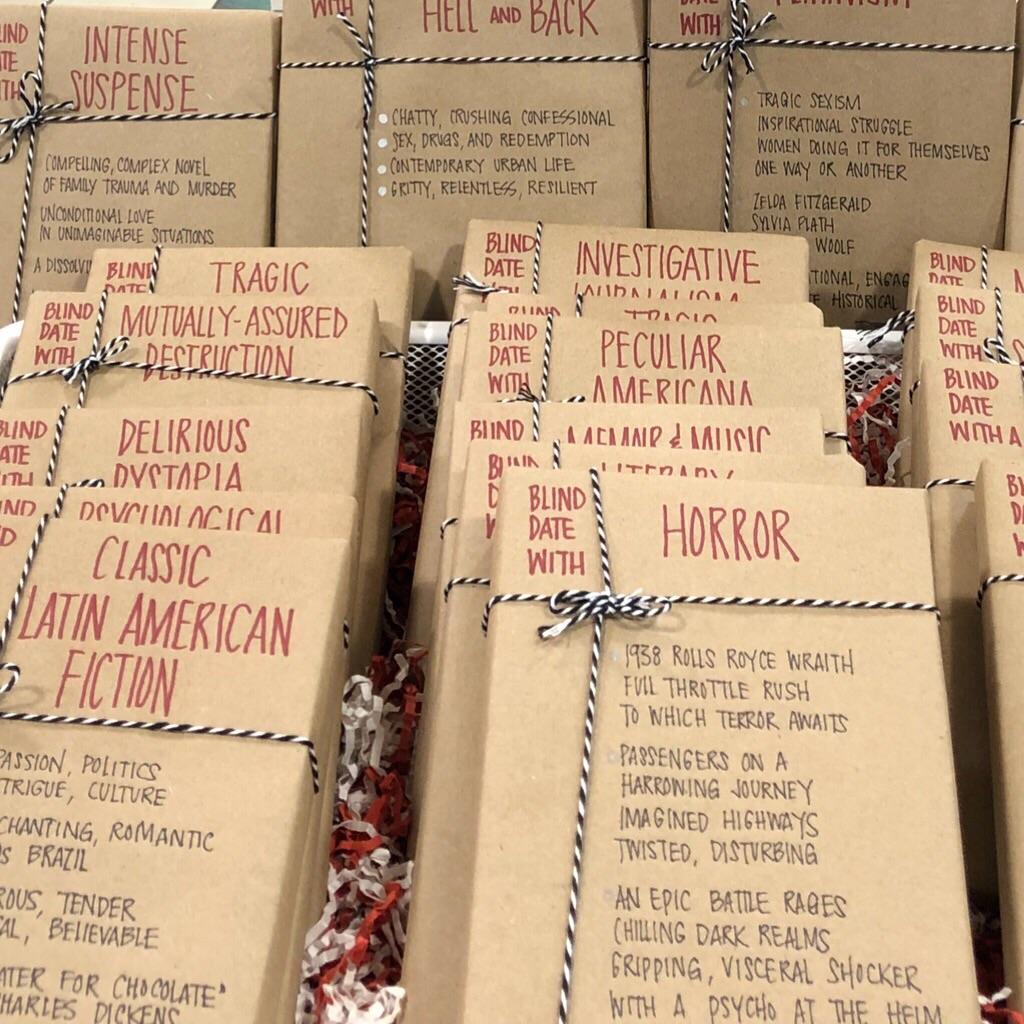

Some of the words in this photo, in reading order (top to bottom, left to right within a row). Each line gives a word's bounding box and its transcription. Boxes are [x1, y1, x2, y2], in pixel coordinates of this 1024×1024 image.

[490, 6, 521, 23] AND
[680, 12, 720, 36] WITH
[84, 26, 187, 65] INTENSE
[71, 71, 199, 113] SUSPENSE
[758, 91, 801, 108] TRAGIC
[810, 92, 860, 110] SEXISM
[392, 109, 441, 129] CHATTY,
[451, 108, 511, 125] CRUSHING
[522, 110, 614, 126] CONFESSIONAL
[759, 116, 843, 133] INSPIRATIONAL
[851, 117, 912, 136] STRUGGLE
[393, 132, 416, 152] SEX,
[422, 132, 463, 150] DRUGS,
[500, 132, 589, 147] REDEMPTION
[758, 138, 800, 153] WOMEN
[810, 140, 848, 156] DOING
[909, 142, 990, 161] THEMSELVES
[117, 157, 169, 174] COMPLEX
[175, 157, 210, 176] NOVEL
[390, 157, 484, 175] CONTEMPORARY
[494, 157, 537, 172] URBAN
[545, 157, 575, 172] LIFE
[846, 161, 907, 181] ANOTHER
[60, 177, 97, 195] FAMILY
[103, 178, 149, 195] TRAUMA
[188, 180, 236, 198] MURDER
[528, 180, 597, 195] RESILIENT
[41, 204, 122, 224] UNCONDITIONAL
[754, 192, 786, 210] ZELDA
[795, 194, 871, 212] FITZGERALD
[58, 226, 143, 243] UNIMAGINABLE
[152, 228, 214, 244] SITUATIONS
[752, 213, 791, 231] SYLVIA
[798, 216, 834, 233] PLATH
[577, 240, 760, 284] INVESTIGATIVE
[210, 262, 309, 295] TRAGIC
[121, 305, 347, 338] MUTUALLY-ASSURED
[144, 344, 294, 382] DESTRUCTION
[602, 330, 726, 373] PECULIAR
[944, 368, 999, 390] BLIND
[949, 393, 993, 416] DATE
[118, 418, 249, 456] DELIRIOUS
[529, 485, 586, 512] BLIND
[529, 515, 575, 540] DATE
[663, 503, 799, 562] HORROR
[93, 536, 211, 588] CLASSIC
[528, 549, 585, 575] WITH
[18, 585, 110, 641] LATIN
[118, 593, 294, 656] AMERICAN
[626, 644, 660, 669] 1938
[673, 645, 715, 668] ROLLS
[727, 649, 775, 672] ROYCE
[787, 649, 854, 675] WRAITH
[55, 650, 178, 717] FICTION
[624, 675, 656, 696] FULL
[663, 677, 748, 699] THROTTLE
[763, 680, 809, 701] RUSH
[649, 706, 706, 727] WHICH
[716, 710, 780, 730] TERROR
[789, 711, 848, 733] AWAITS
[82, 754, 161, 781] POLITICS
[620, 744, 728, 771] PASSENGERS
[88, 781, 166, 806] CULTURE
[622, 773, 719, 800] HARROWING
[731, 779, 813, 805] JOURNEY
[109, 821, 214, 851] ROMANTIC
[620, 806, 708, 833] IMAGINED
[723, 809, 818, 840] HIGHWAYS
[28, 845, 87, 872] BRAZIL
[711, 840, 817, 865] DISTURBING
[57, 891, 135, 921] TENDER
[650, 888, 690, 916] EPIC
[710, 890, 770, 914] BATTLE
[784, 891, 846, 918] RAGES
[49, 917, 157, 949] BELIEVABLE
[614, 917, 685, 945] CHILLING
[696, 923, 749, 947] DARK
[759, 924, 830, 953] REALMS
[722, 956, 813, 984] VISCERAL
[827, 956, 922, 994] SHOCKER
